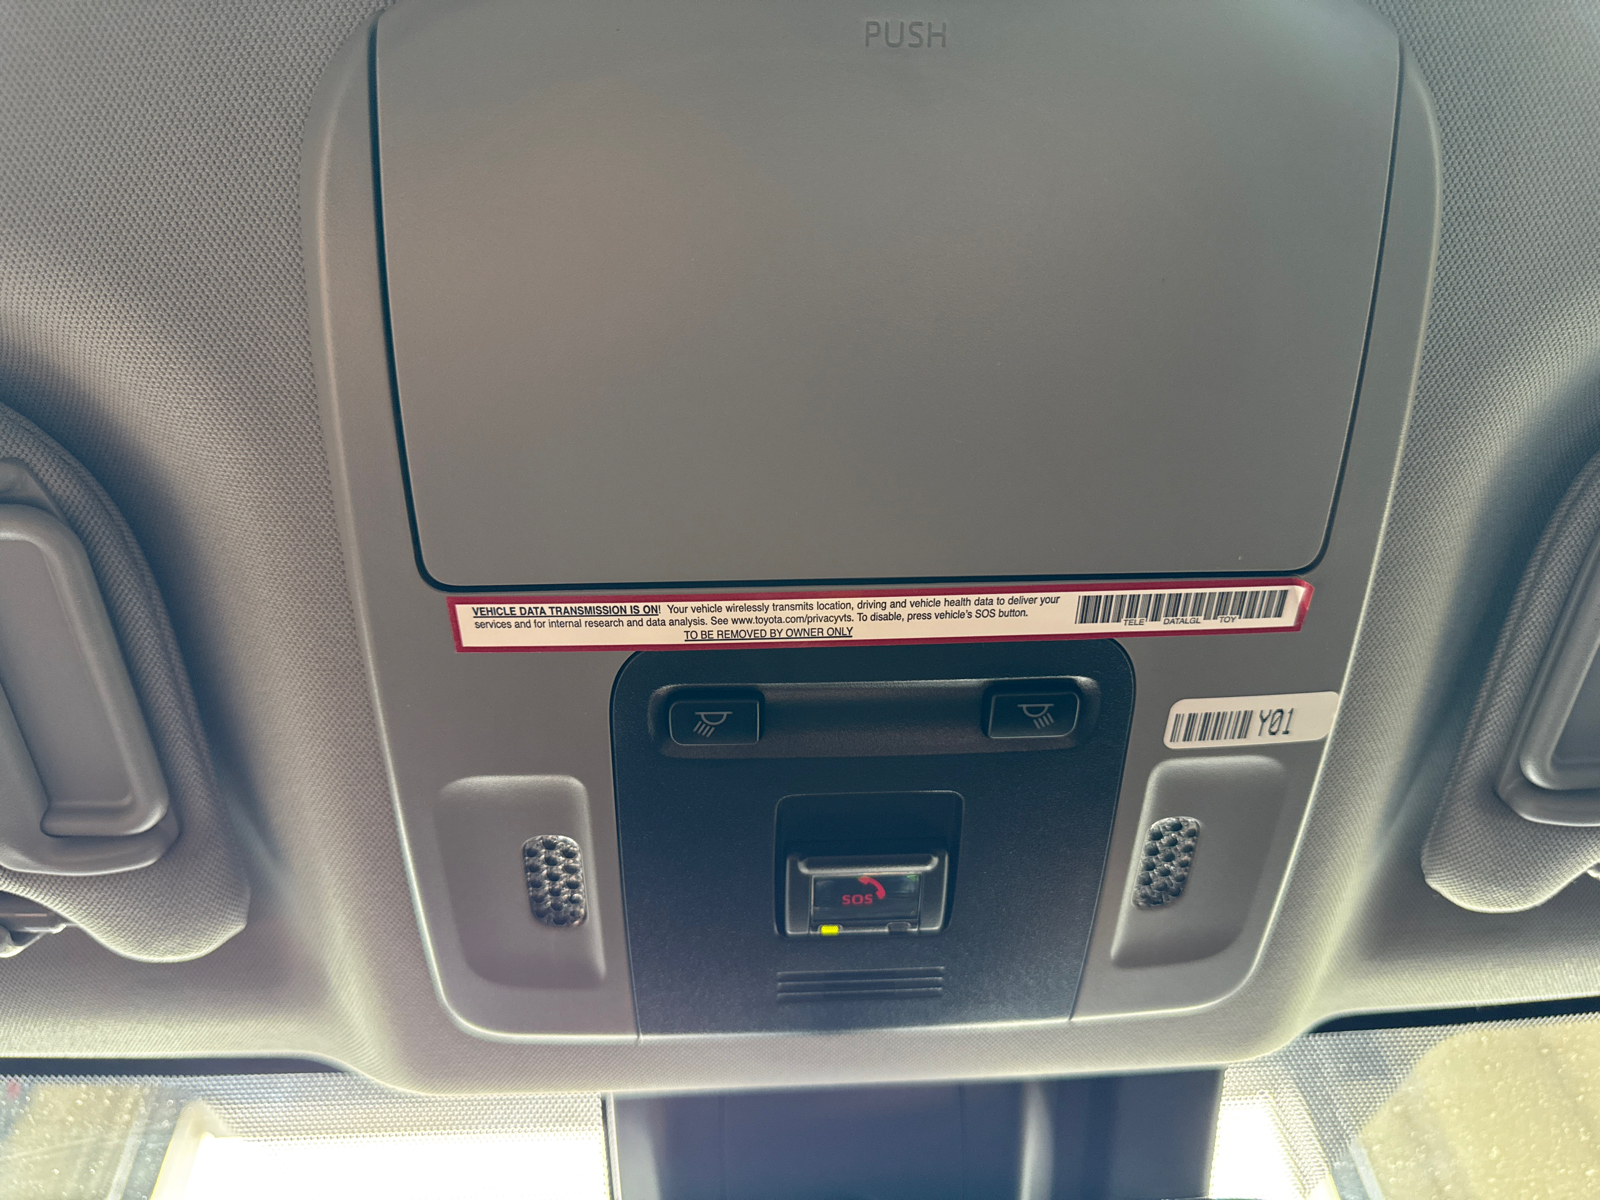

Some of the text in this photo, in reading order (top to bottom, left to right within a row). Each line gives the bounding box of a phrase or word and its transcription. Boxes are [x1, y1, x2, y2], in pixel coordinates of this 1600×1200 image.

[866, 21, 946, 48] PUSH
[472, 596, 1060, 616] VEHICLE DATA TRANSMISSION IS ON! Your vehicle wirelessly transmits location, driving and vehicle health data to deliver your
[475, 620, 512, 628] services
[515, 619, 532, 628] and
[534, 619, 546, 628] for
[548, 619, 582, 628] internal
[585, 618, 624, 627] research
[627, 618, 644, 626] and
[646, 618, 665, 626] data
[669, 617, 707, 627] analysis.
[711, 616, 728, 625] See
[731, 613, 854, 625] www.toyota.com/privacyvts.
[858, 613, 868, 622] To
[870, 612, 904, 622] disable,
[907, 612, 932, 622] press
[975, 609, 996, 618] SOS
[998, 609, 1028, 618] button.
[684, 627, 853, 640] TO BE REMOVED BY OWNER ONLY
[1258, 708, 1294, 736] Y01
[842, 894, 873, 905] SOS
